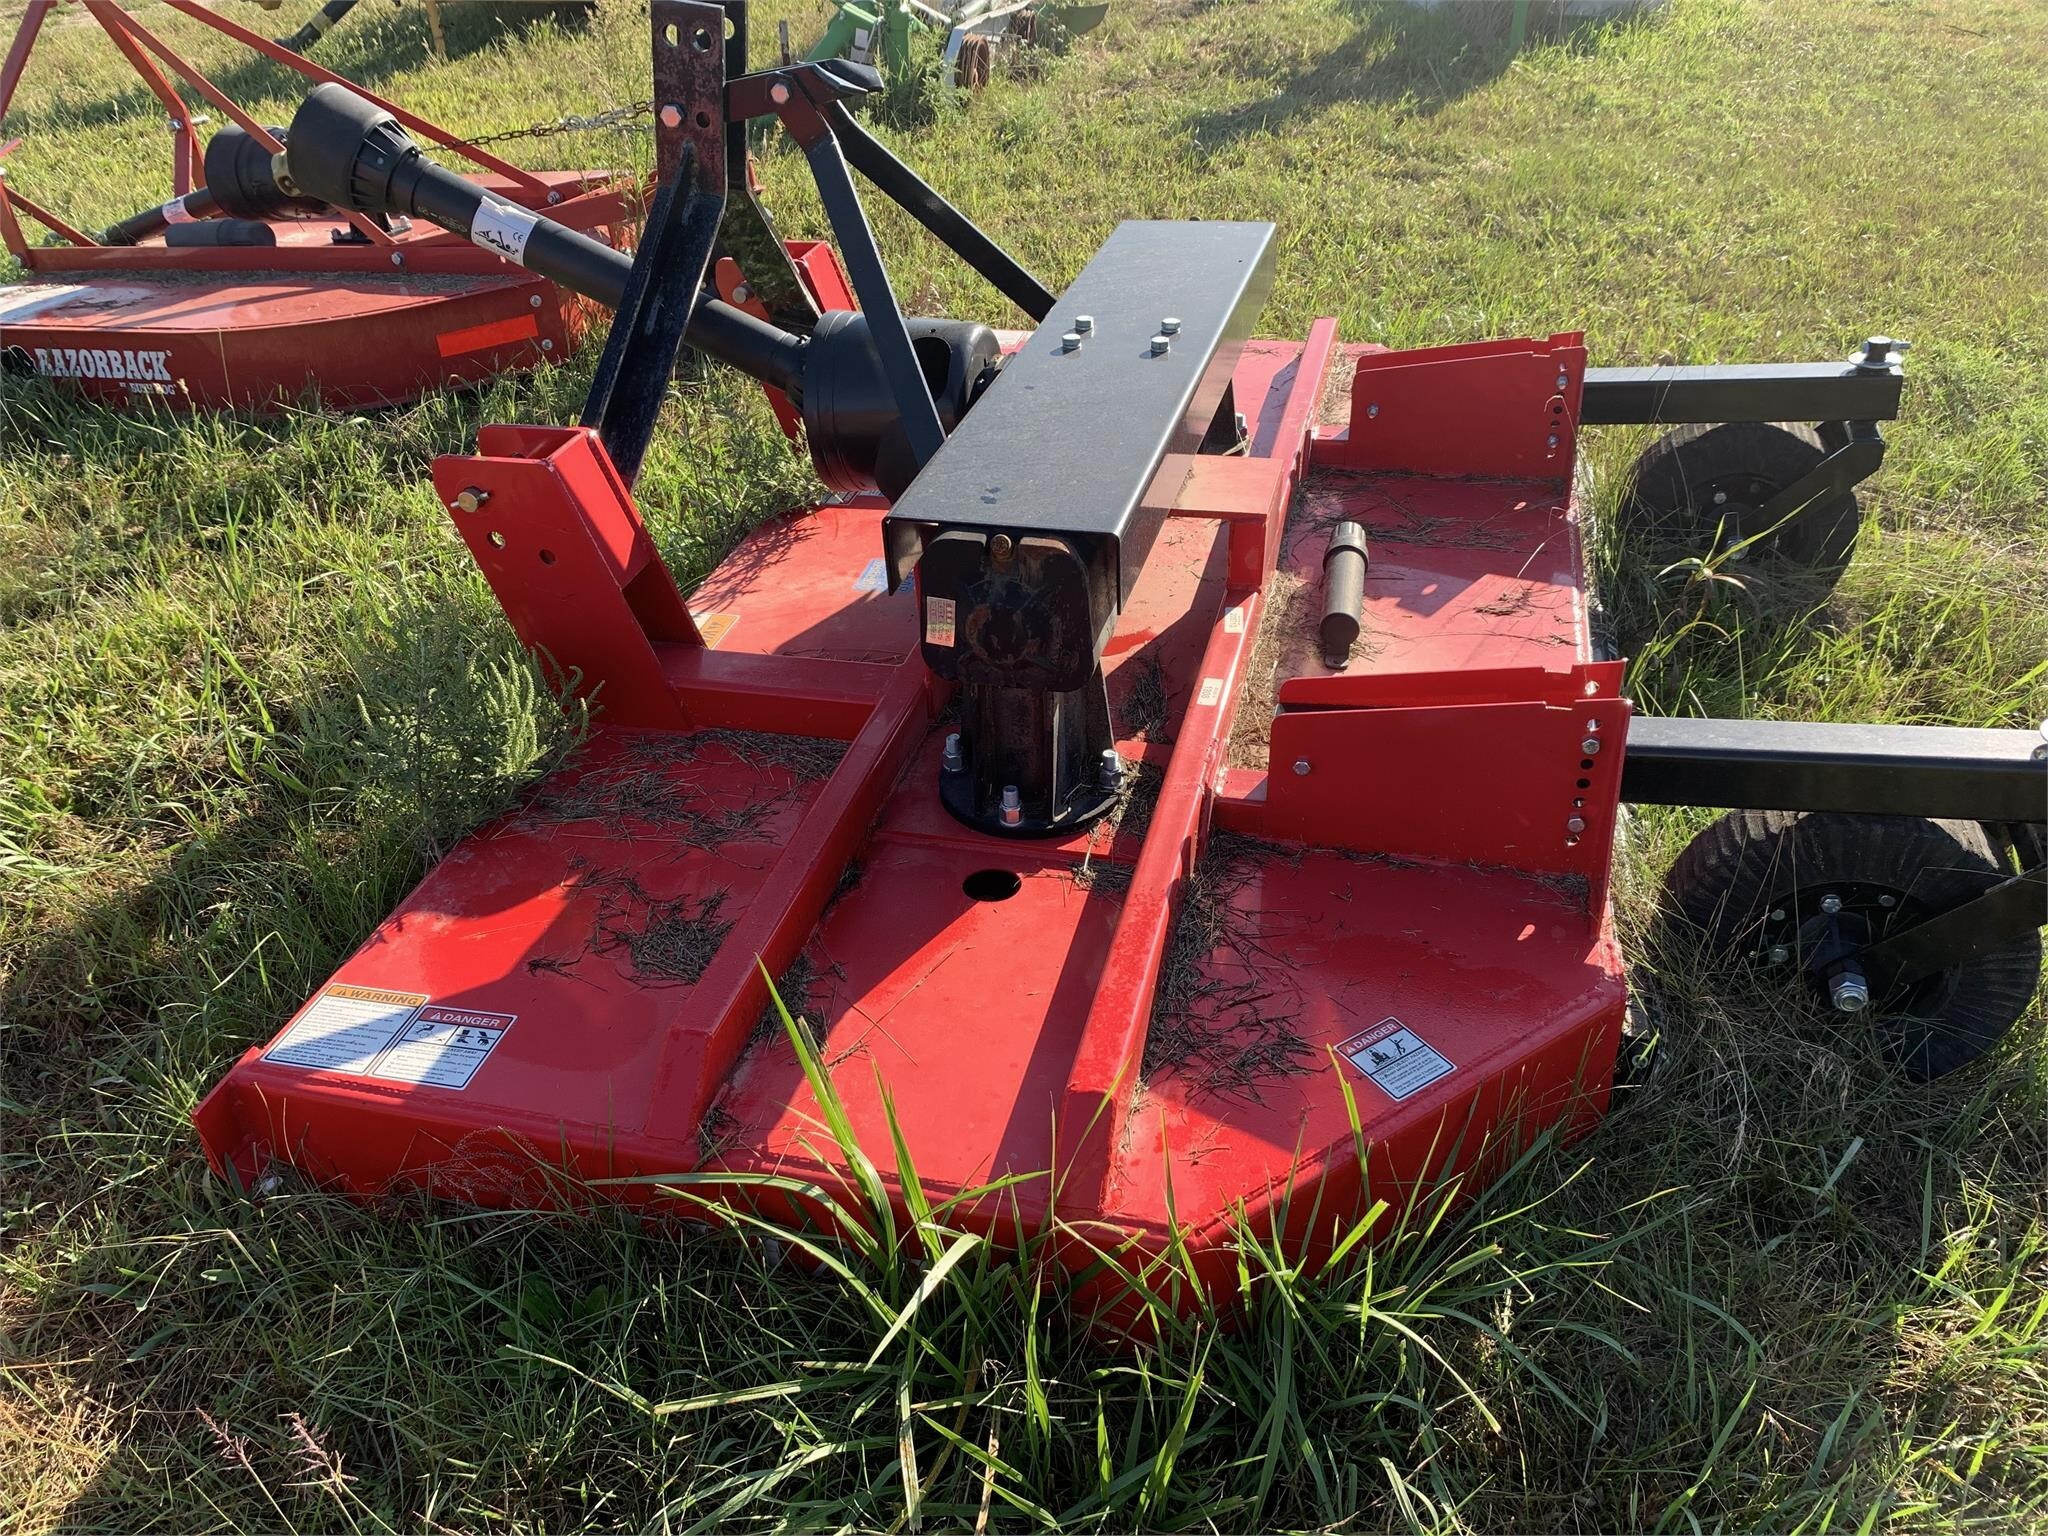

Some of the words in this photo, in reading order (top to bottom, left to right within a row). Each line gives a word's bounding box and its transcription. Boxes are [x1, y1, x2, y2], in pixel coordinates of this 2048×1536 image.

[35, 348, 171, 381] RAZORBACK
[154, 382, 175, 395] OG
[350, 990, 418, 1005] WARNING
[443, 1013, 500, 1027] DANGER
[1352, 1023, 1397, 1048] DANGER
